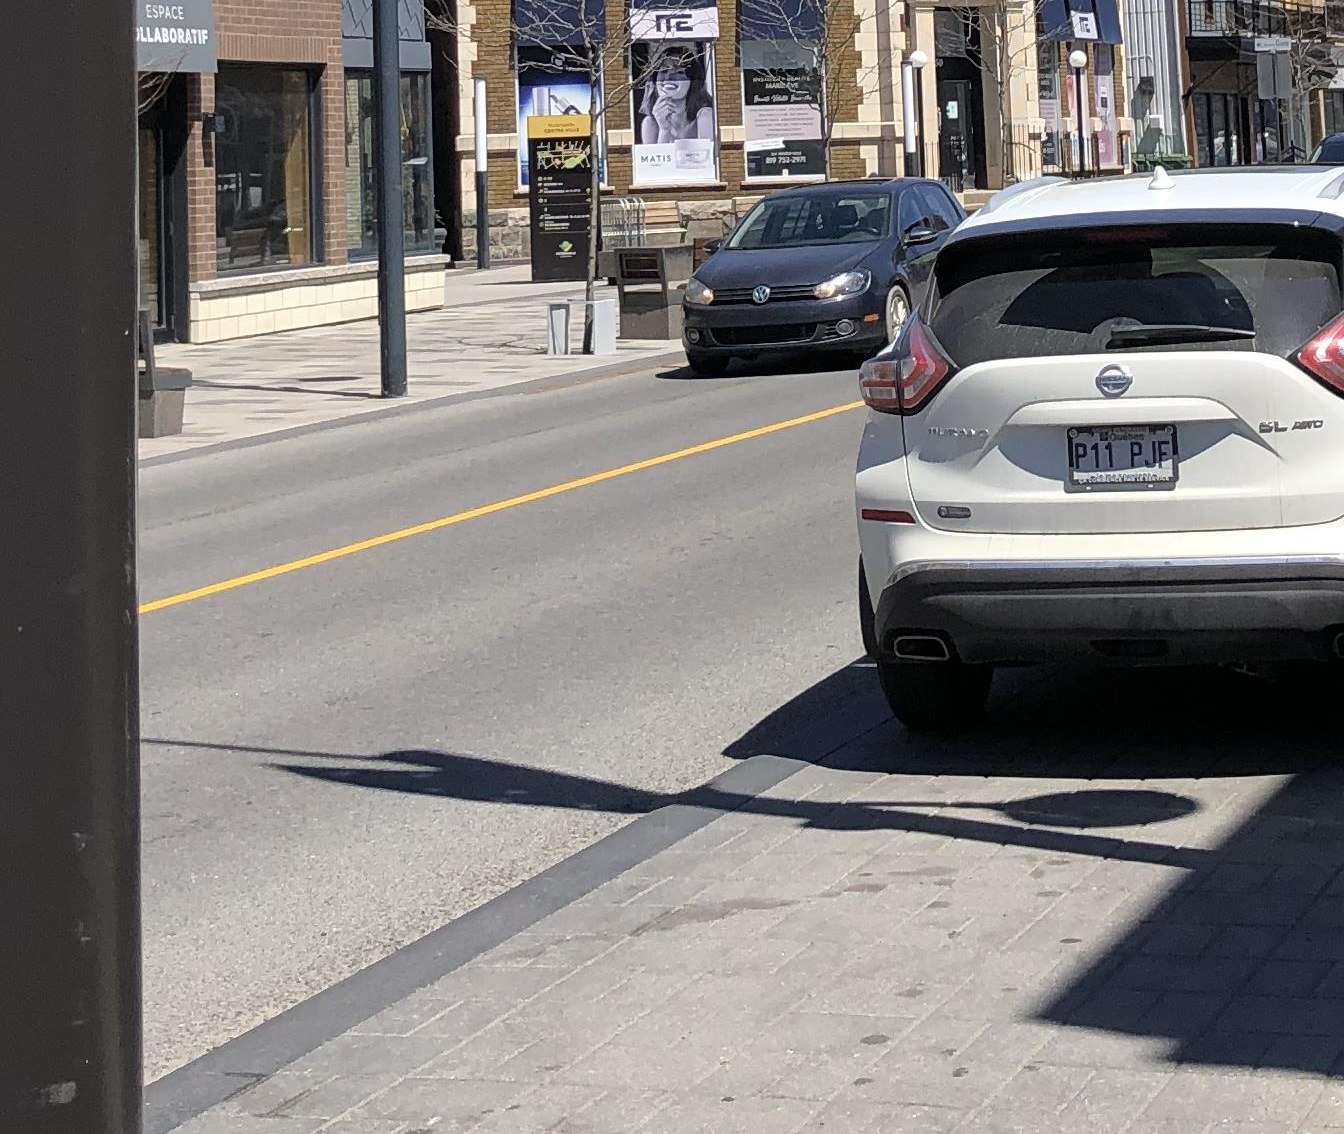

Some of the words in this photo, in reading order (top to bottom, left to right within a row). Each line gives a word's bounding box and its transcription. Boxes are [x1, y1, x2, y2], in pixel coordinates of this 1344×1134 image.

[145, 4, 185, 20] ESPACE
[136, 27, 209, 45] LLABORATIF
[640, 154, 672, 163] MATIS
[1074, 442, 1114, 470] P11
[1130, 440, 1170, 469] PJF
